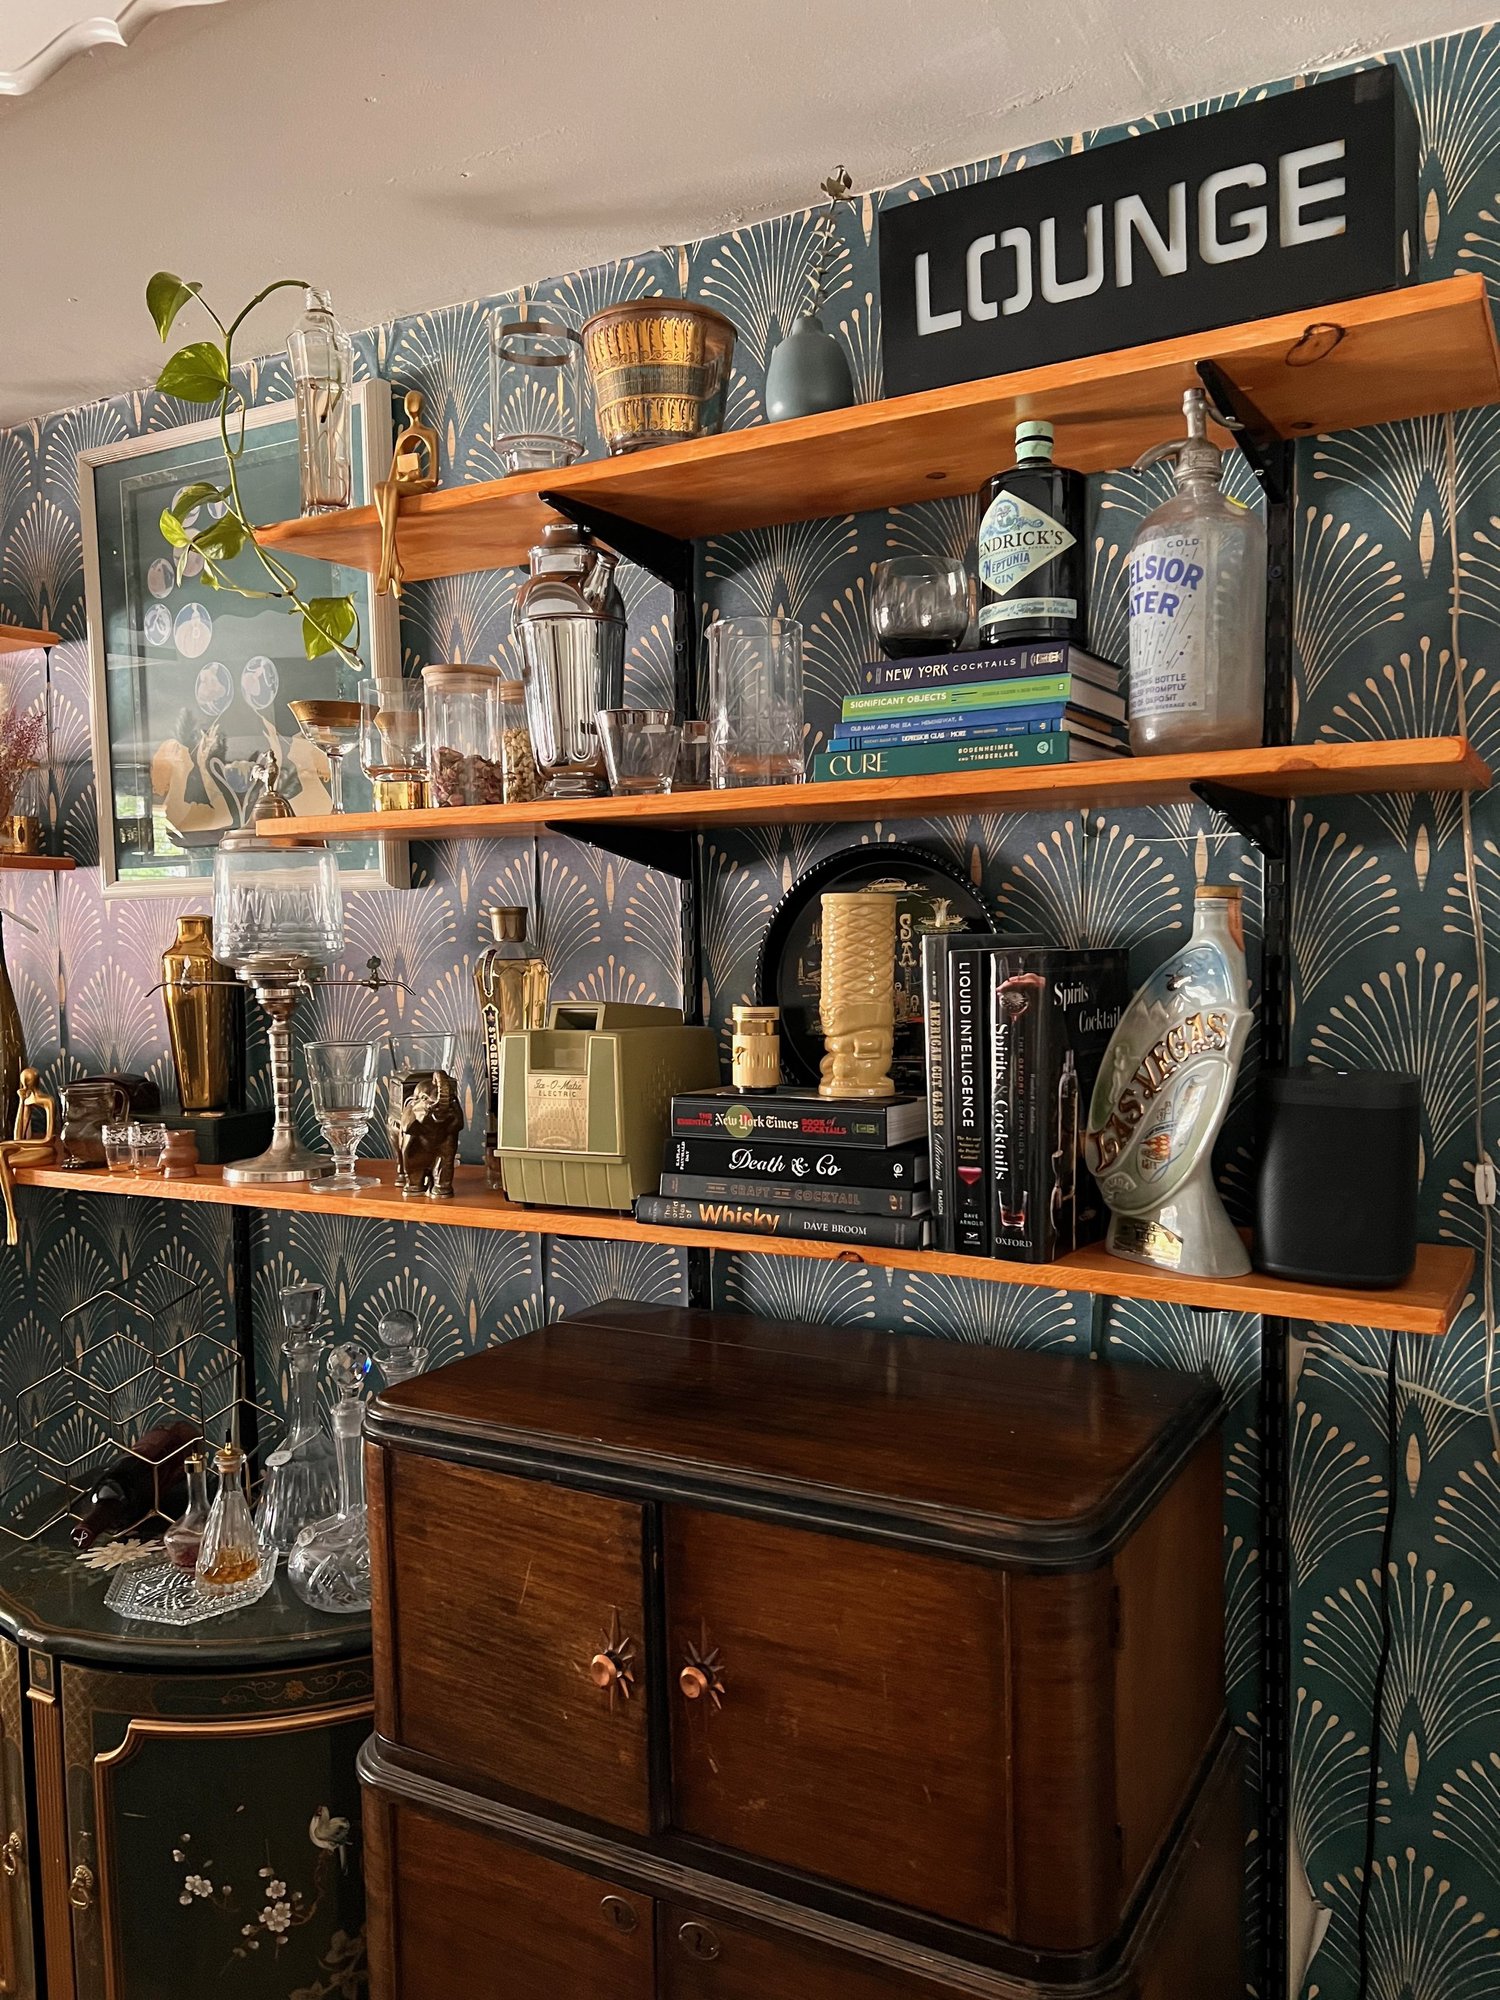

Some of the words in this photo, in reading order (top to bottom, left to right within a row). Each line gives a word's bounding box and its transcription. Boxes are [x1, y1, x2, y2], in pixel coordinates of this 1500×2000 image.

[915, 138, 1346, 337] LOUNGE
[979, 529, 1065, 558] ENDRICK'S
[1166, 538, 1199, 548] COLD
[983, 552, 1031, 580] NEPTUNIA
[994, 573, 1015, 585] GIN
[1130, 555, 1204, 591] ELSIOR
[1128, 591, 1180, 617] ATER
[885, 667, 914, 682] NEW
[918, 663, 949, 678] YORK
[952, 658, 1017, 672] COCKTAILS
[1155, 673, 1187, 684] BOTTLE
[850, 696, 905, 709] SIGNIFICANT
[906, 692, 947, 704] OBJECTS
[1145, 683, 1187, 694] PROMPTLY
[958, 743, 1014, 754] BODENHEIMER
[970, 751, 1019, 761] TIMBERLAKE
[829, 751, 889, 777] CURE
[958, 962, 972, 1015] LIQUID
[1053, 981, 1089, 1012] Spirits
[929, 1000, 942, 1062] AMERICAN
[1079, 1005, 1121, 1034] Cocktail
[488, 1025, 499, 1095] ST-GERMAIN
[995, 1023, 1009, 1080] Spirits
[931, 1066, 943, 1089] CUT
[960, 1019, 975, 1128] INTELLIGENCE
[538, 1090, 577, 1098] ELECTRIC
[1089, 1087, 1145, 1173] LAS
[1131, 1011, 1228, 1100] VEGAS
[801, 1118, 826, 1126] BOOK
[826, 1116, 837, 1126] of
[932, 1089, 944, 1127] GLASS
[714, 1112, 737, 1127] New
[738, 1114, 765, 1131] York
[765, 1115, 799, 1130] Times
[801, 1125, 848, 1135] COCKTAILS
[994, 1099, 1009, 1181] Cocktails
[728, 1148, 786, 1173] Death
[791, 1157, 811, 1177] &
[815, 1153, 842, 1176] Co
[1018, 1159, 1025, 1171] TO
[730, 1184, 770, 1198] CRAFT
[794, 1189, 861, 1206] COCKTAIL
[698, 1202, 780, 1235] Whisky
[803, 1221, 829, 1232] DAVE
[831, 1223, 867, 1236] BROOM
[959, 1219, 984, 1227] ARNOLD
[995, 1236, 1033, 1248] OXFORD
